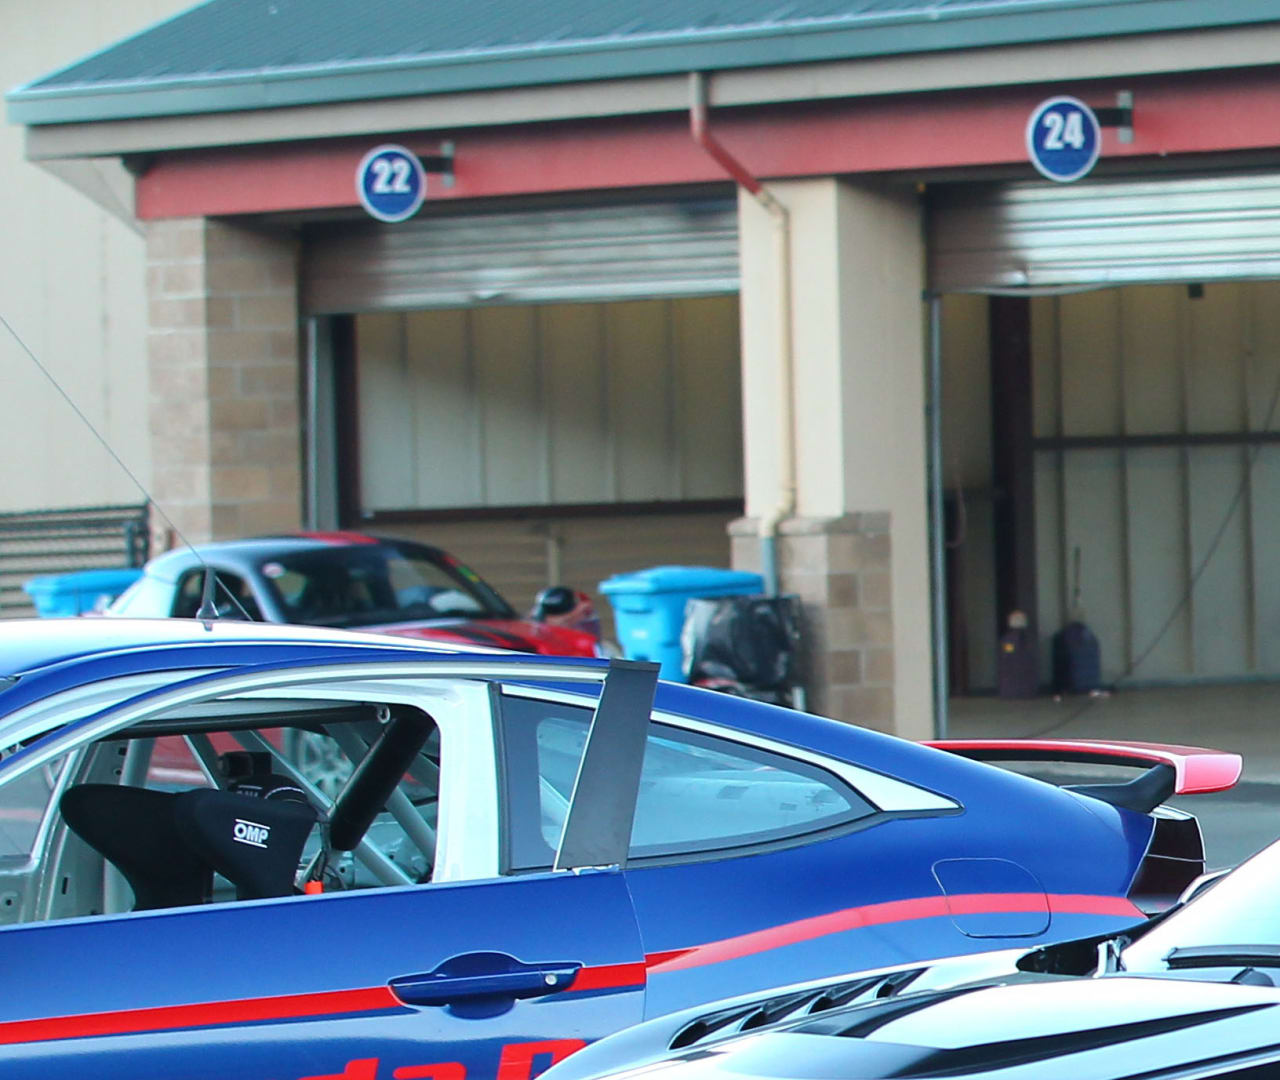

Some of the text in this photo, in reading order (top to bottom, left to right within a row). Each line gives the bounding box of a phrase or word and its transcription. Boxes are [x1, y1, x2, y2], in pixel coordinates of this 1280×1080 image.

[1043, 111, 1086, 150] 24
[372, 158, 412, 194] 22
[234, 822, 269, 844] OMP
